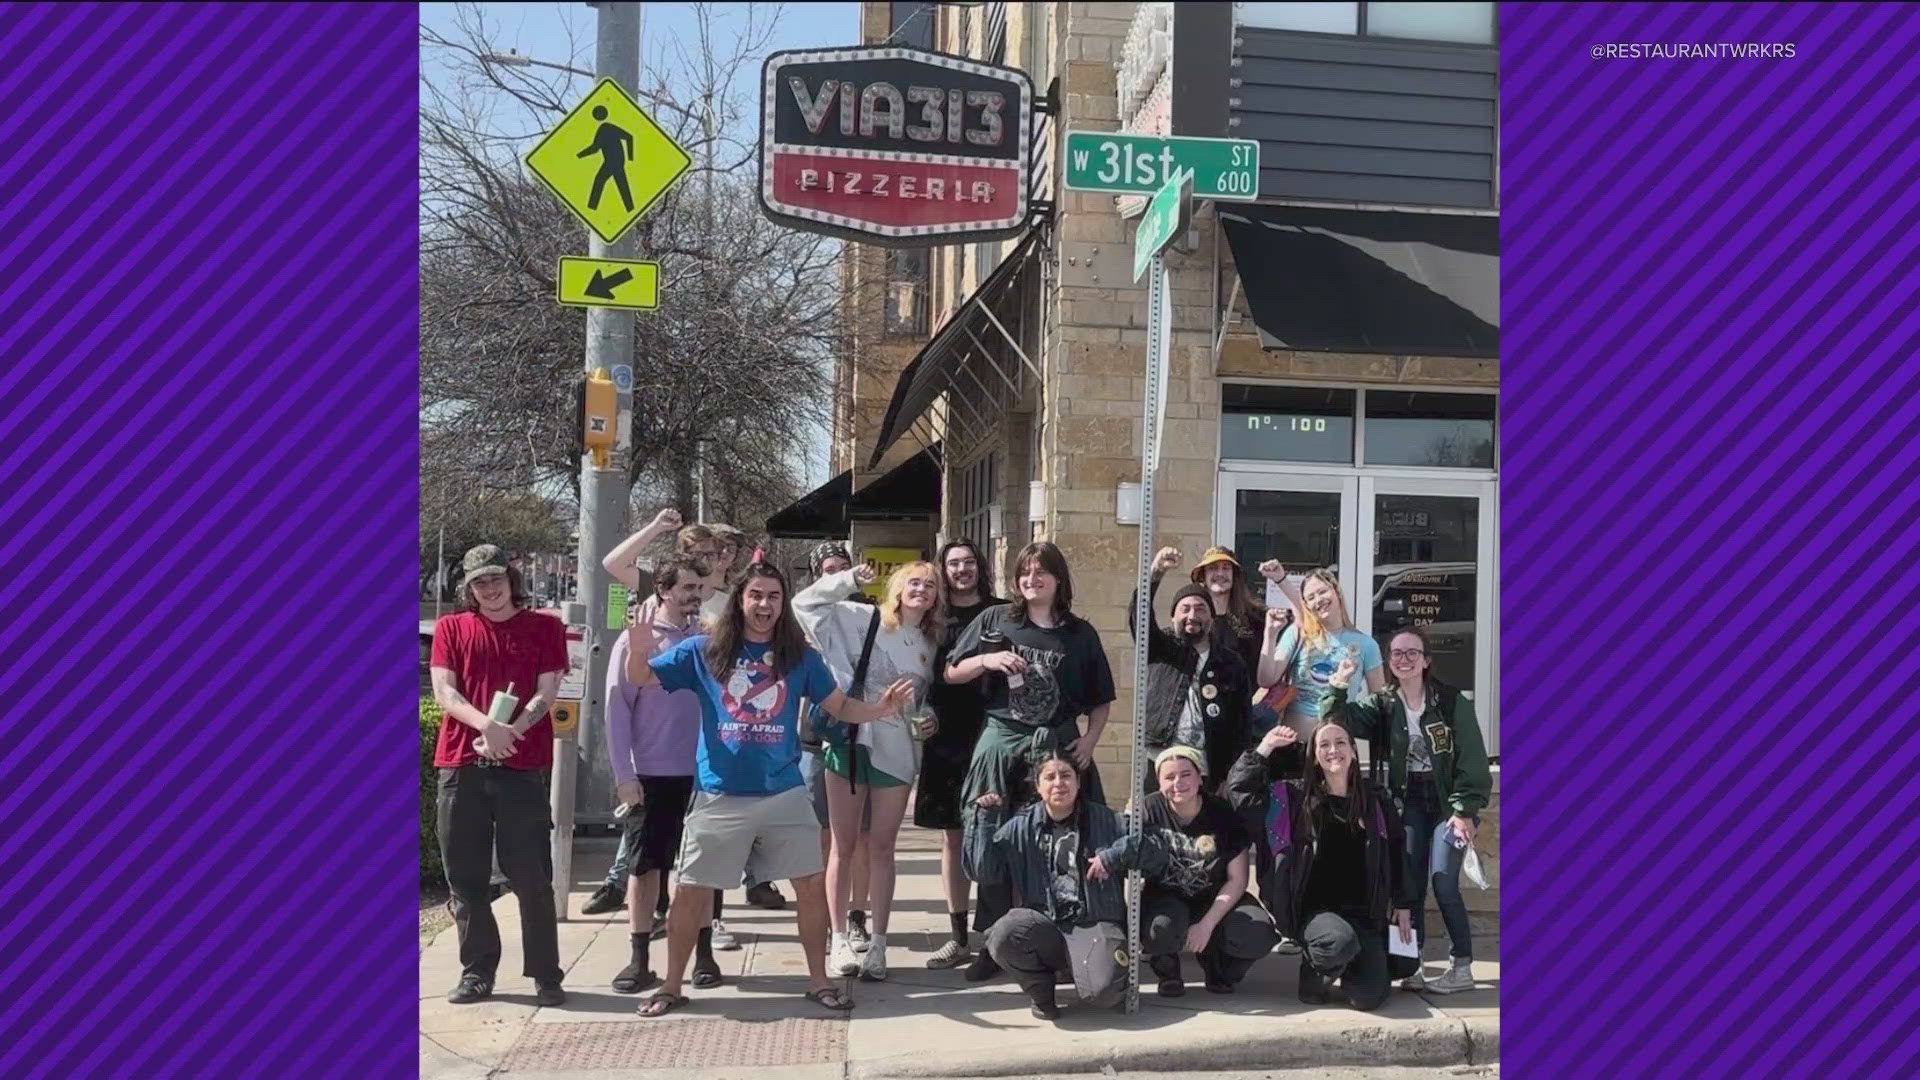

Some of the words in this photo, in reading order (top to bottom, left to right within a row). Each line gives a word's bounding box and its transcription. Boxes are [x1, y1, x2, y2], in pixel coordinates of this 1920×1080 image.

[788, 76, 1005, 146] VIA313
[1074, 149, 1089, 172] W
[1097, 141, 1174, 186] 31st
[1231, 145, 1251, 167] ST
[800, 168, 992, 204] PIZZERIA
[1217, 171, 1250, 193] 600
[1291, 417, 1326, 432] 100
[1411, 593, 1439, 603] OPEN
[1407, 605, 1441, 616] EVERY
[1414, 618, 1434, 628] DAY
[722, 723, 749, 731] AIN'T
[751, 725, 785, 733] AFRAID
